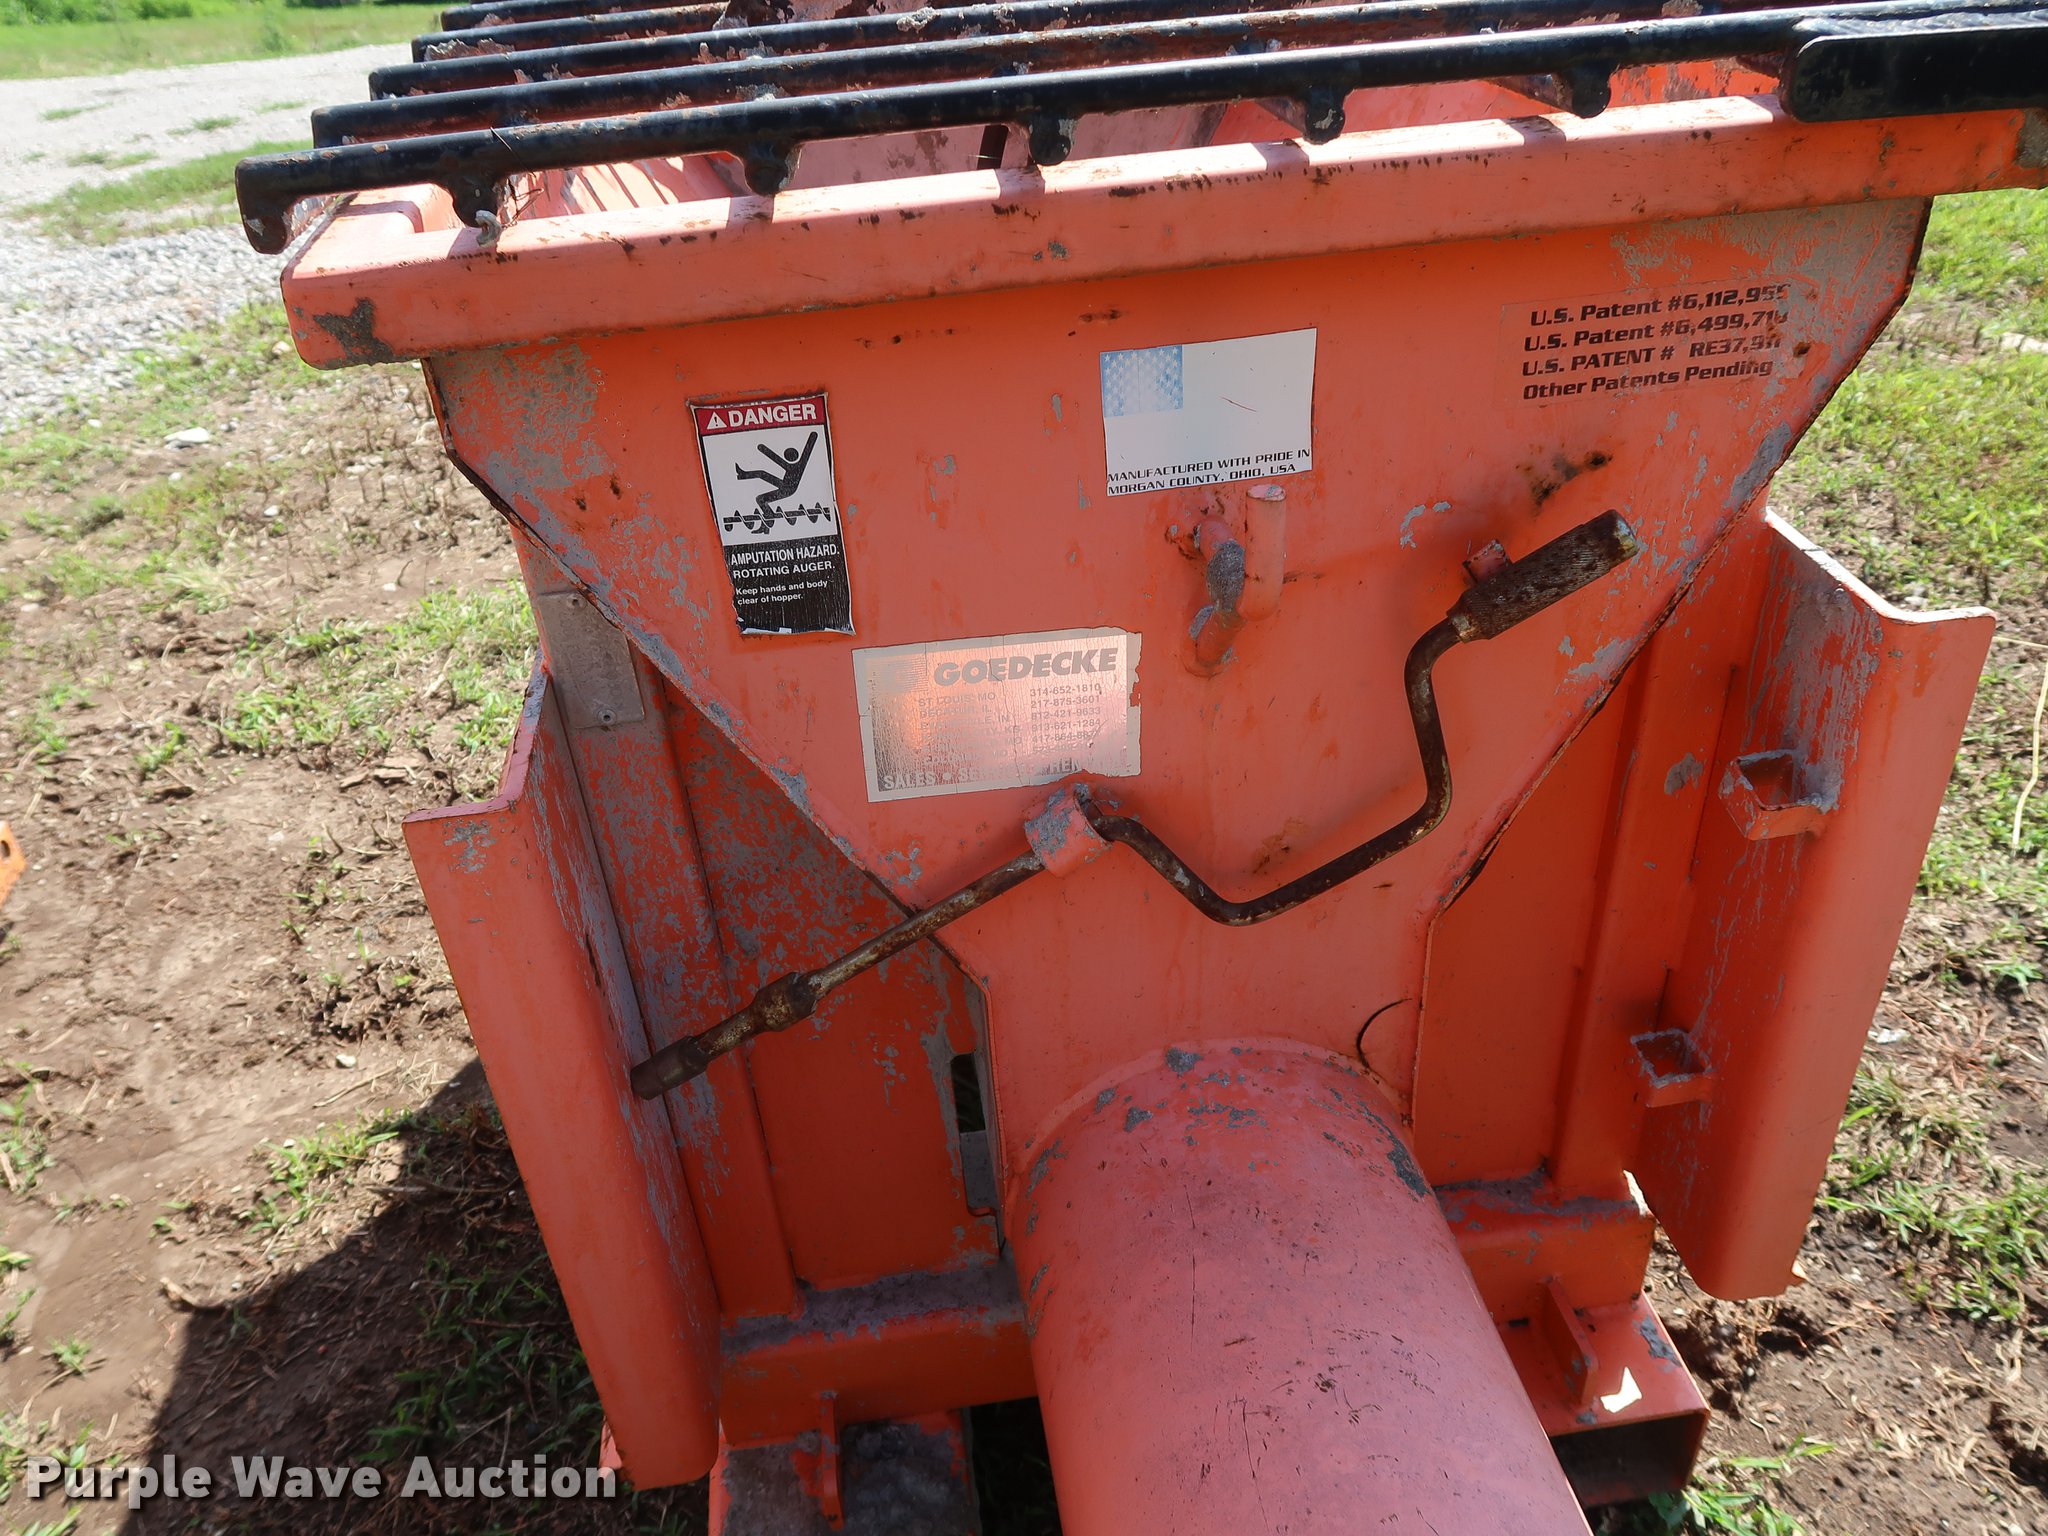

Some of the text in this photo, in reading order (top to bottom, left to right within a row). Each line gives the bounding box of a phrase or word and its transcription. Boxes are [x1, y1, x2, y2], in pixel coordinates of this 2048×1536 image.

[1530, 308, 1575, 326] U.S.
[1580, 299, 1662, 321] Patent
[1524, 333, 1568, 352] U.S.
[1573, 325, 1654, 346] Patent
[1522, 358, 1565, 376] U.S.
[1571, 347, 1656, 370] PATENT
[1660, 345, 1674, 360] #
[1523, 360, 1773, 400] Other Patents Pending
[728, 403, 817, 427] DANGER
[1107, 448, 1310, 482] MANUFACTURED WITH PRIDE IN
[1108, 463, 1296, 495] MORGAN COUNTY, OHIO, USA
[731, 543, 840, 565] AMPUTATION HAZARD.
[733, 561, 835, 579] ROTATING AUGER.
[736, 579, 828, 596] Keep hands and body
[737, 592, 803, 605] clear of hopper.
[933, 648, 1118, 686] GOEDECKE
[978, 692, 996, 701] MO
[1030, 683, 1101, 697] 314-652-1810
[1030, 695, 1100, 708] 217-875-3601
[883, 770, 937, 789] SALES
